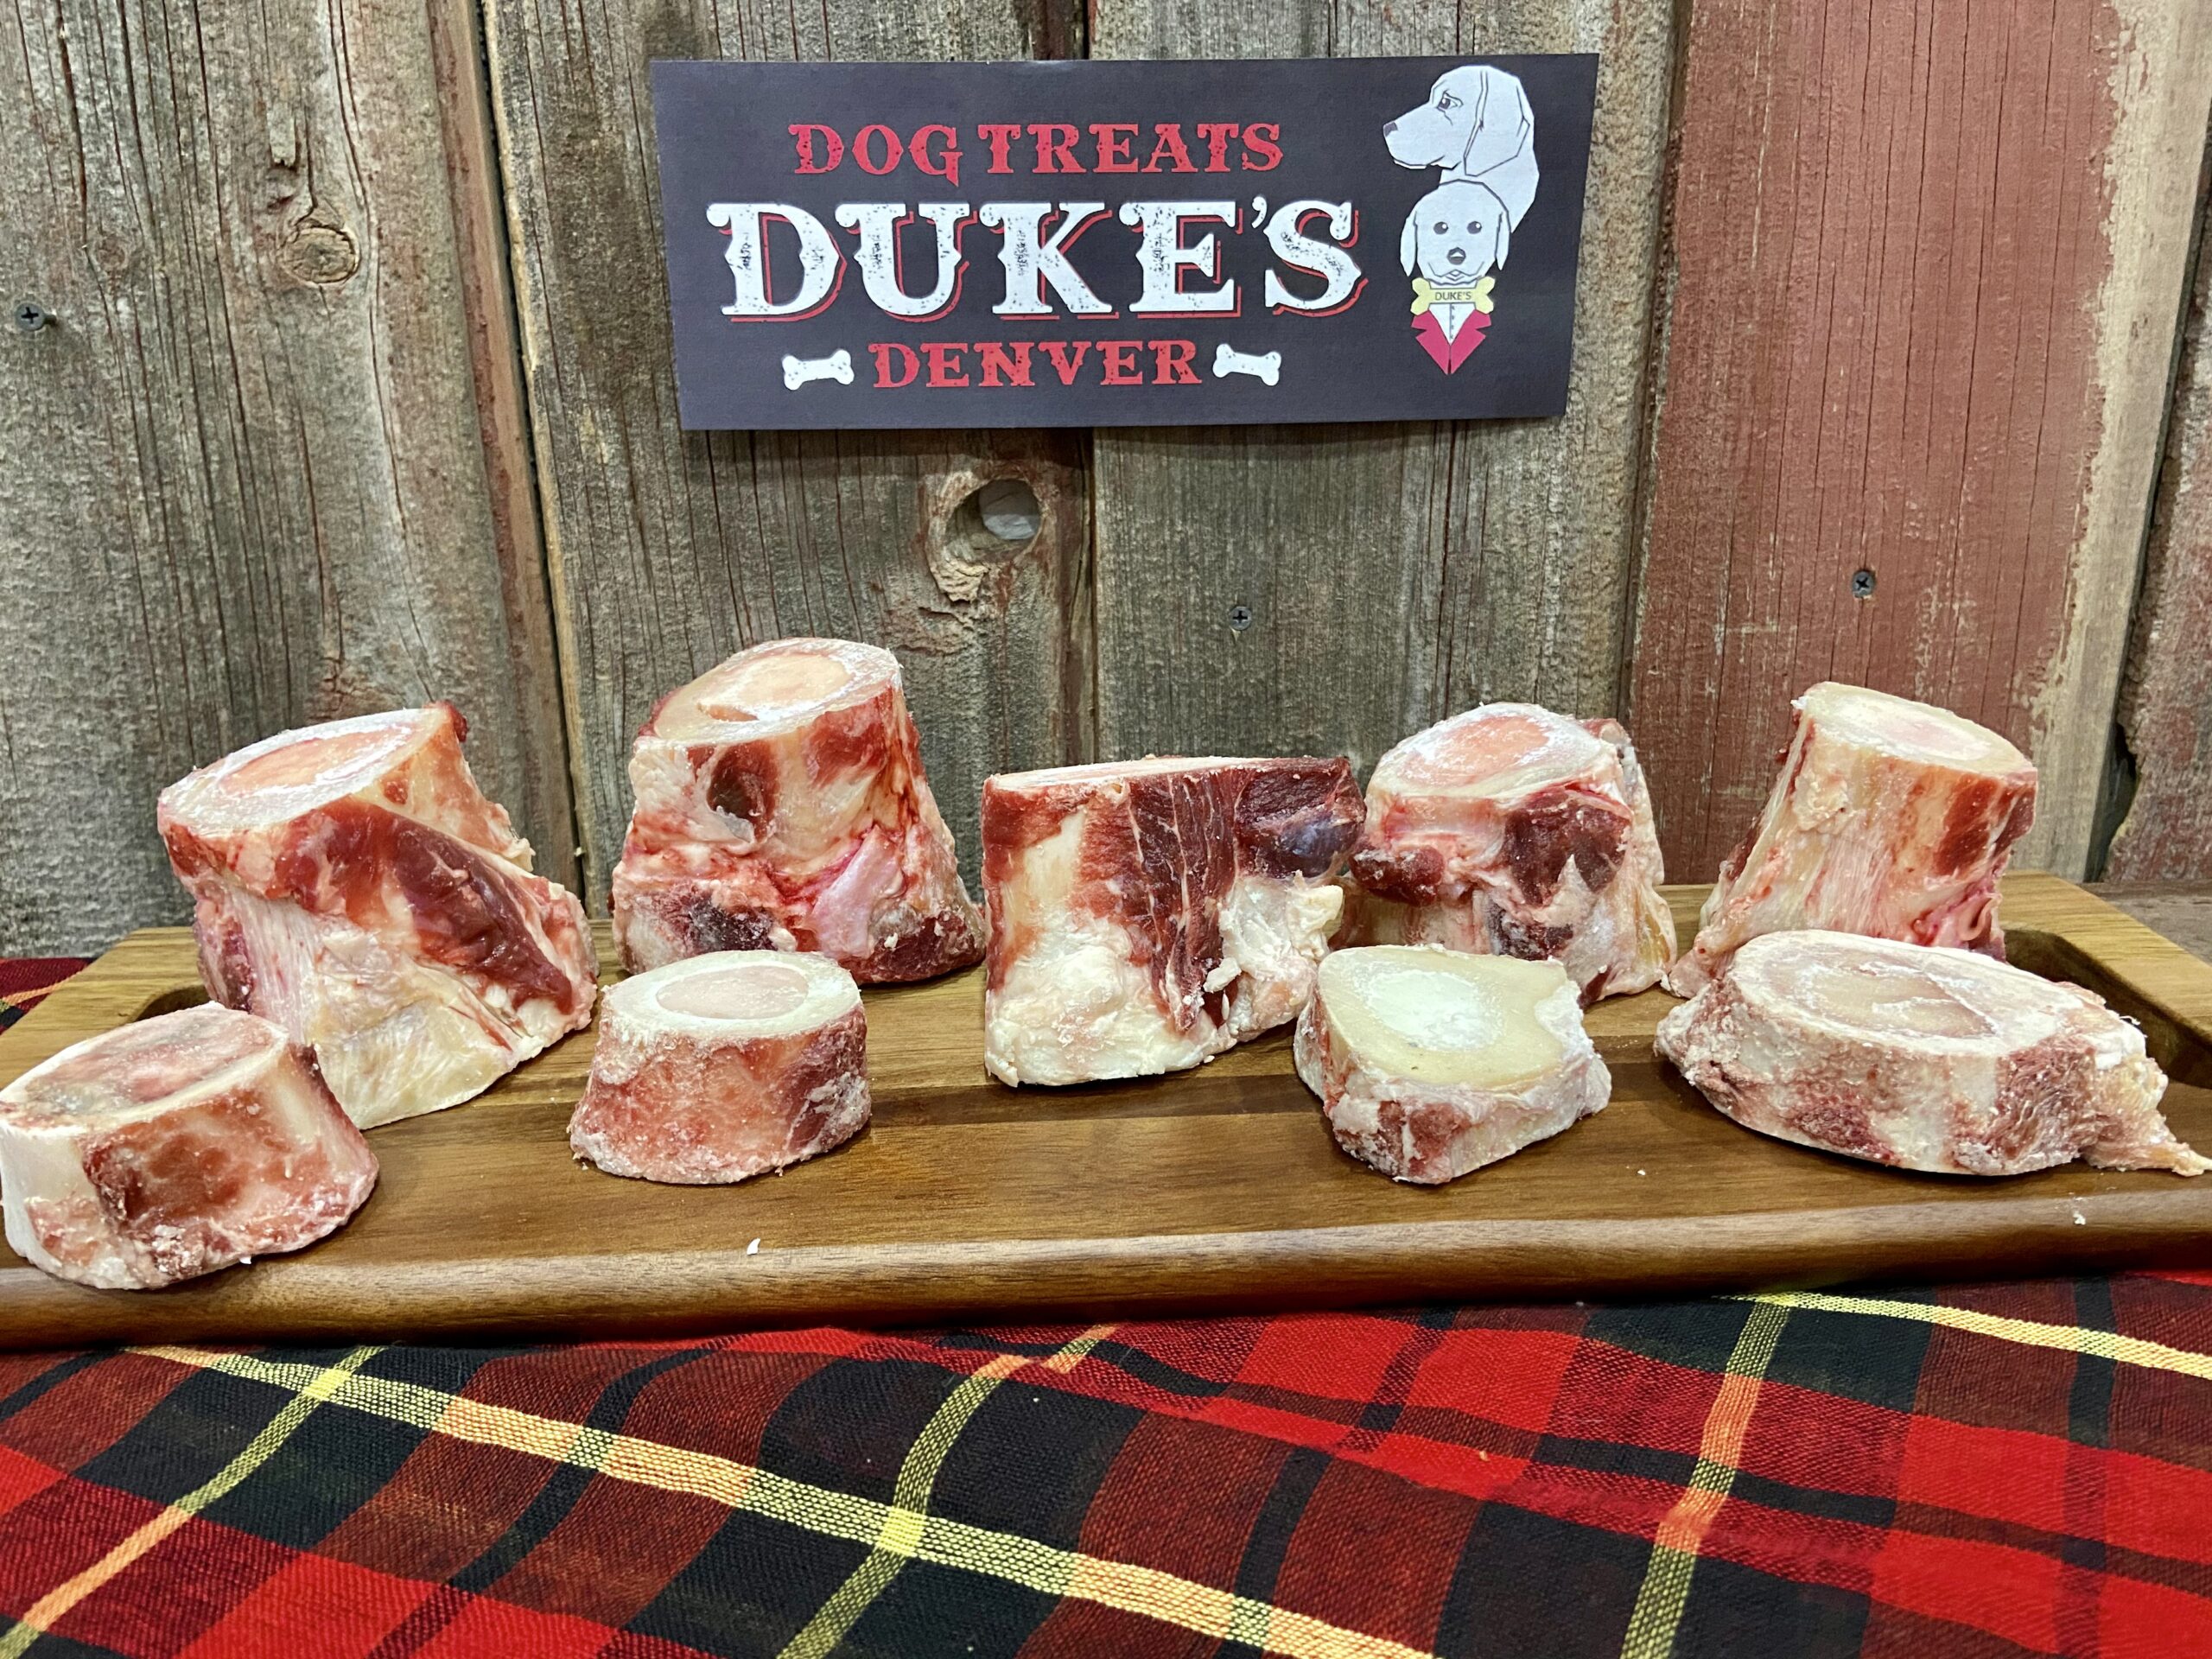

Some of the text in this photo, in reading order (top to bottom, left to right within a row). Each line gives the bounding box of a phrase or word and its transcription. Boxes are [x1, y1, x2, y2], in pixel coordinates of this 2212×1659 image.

[789, 123, 1283, 187] DOG TREATS
[706, 196, 1369, 323] DUKE'S
[1434, 291, 1471, 301] DUKE'S
[868, 340, 1204, 389] DENVER
